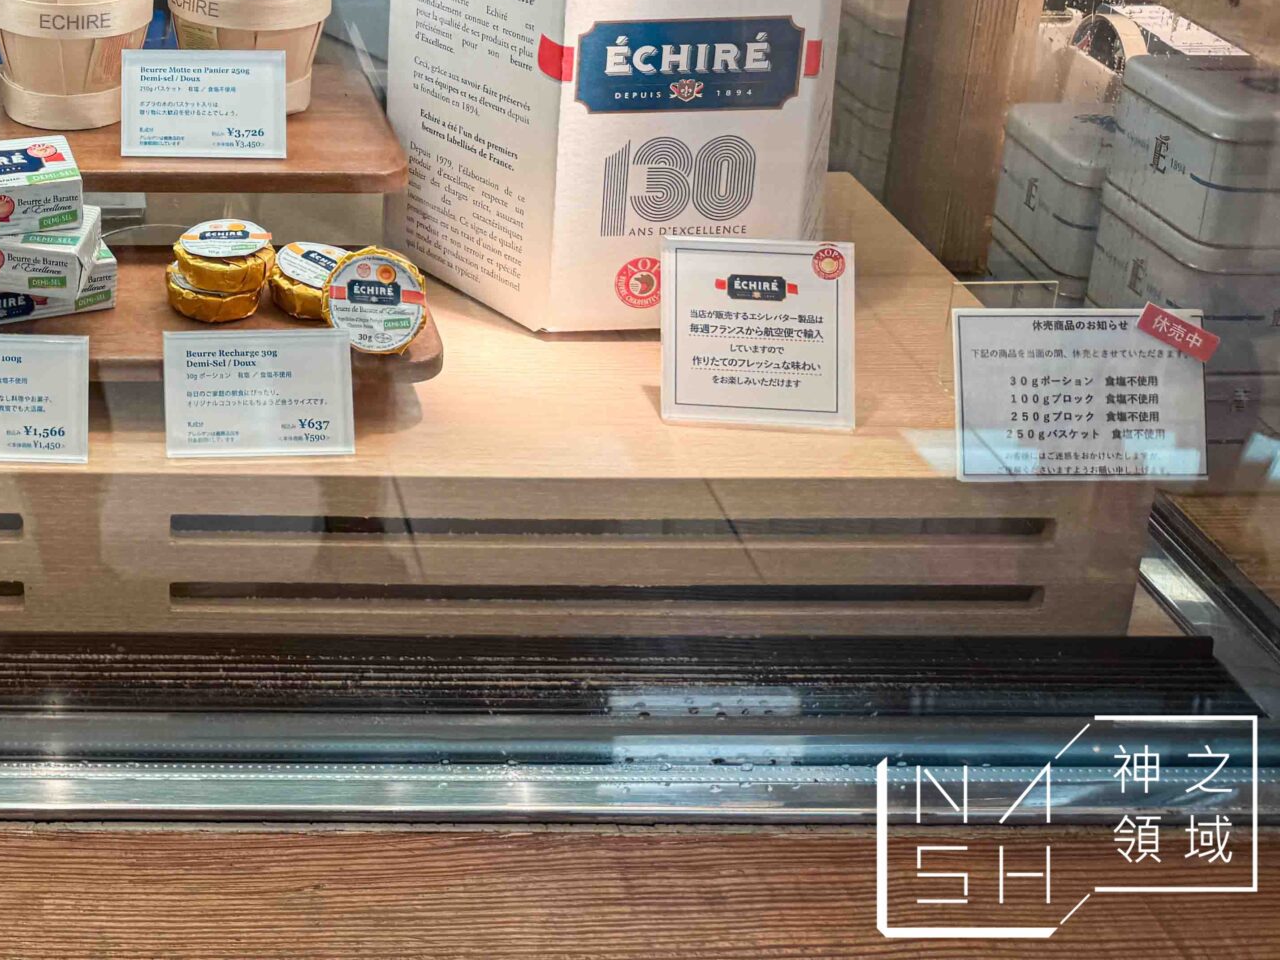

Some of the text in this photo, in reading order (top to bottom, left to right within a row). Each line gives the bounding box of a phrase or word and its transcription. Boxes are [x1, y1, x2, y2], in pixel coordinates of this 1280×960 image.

[39, 13, 111, 30] ECHIRE
[604, 31, 771, 76] ÉCHIRÉ
[510, 55, 533, 71] beurre
[615, 89, 753, 100] DEPUIS 1894
[227, 128, 265, 138] ¥3,726
[1170, 158, 1186, 175] 1894
[600, 135, 756, 237] 130
[17, 195, 79, 206] Beurre de Baratte
[42, 213, 72, 226] DEMI-SEL
[629, 224, 747, 237] ANS D'EXCELLENCE
[7, 253, 68, 268] Beurre de Baratte
[88, 274, 112, 283] Baratte
[734, 278, 779, 291] ÉCHIRÉ
[353, 283, 394, 296] ÉCHIRÉ
[690, 310, 823, 324] 当店が販売するエシレバター製品は
[690, 323, 823, 339] 毎週フランスから航空便で輸入
[1033, 320, 1128, 331] 休売商品のお知らせ
[1153, 314, 1203, 349] 休売中
[186, 349, 277, 358] Beurre Recharge 30g
[730, 344, 784, 354] していますので
[972, 348, 1192, 359] 下記の商品を当面の間、休売とさせていただきます。
[2, 355, 22, 363] 100g
[186, 359, 256, 368] Demi-Sel Doux
[692, 356, 821, 371] 作りたてのフレッシュな味わい
[712, 375, 801, 388] をお楽しみいただけます
[1010, 375, 1158, 387] 30gポーション 食塩不使用
[1011, 393, 1159, 405] 100gブロック 食塩不使用
[1010, 411, 1159, 423] 250gブロック 食塩不使用
[298, 418, 330, 431] ¥637
[24, 426, 65, 438] ¥1,566
[1112, 429, 1166, 440] 食塩不使用
